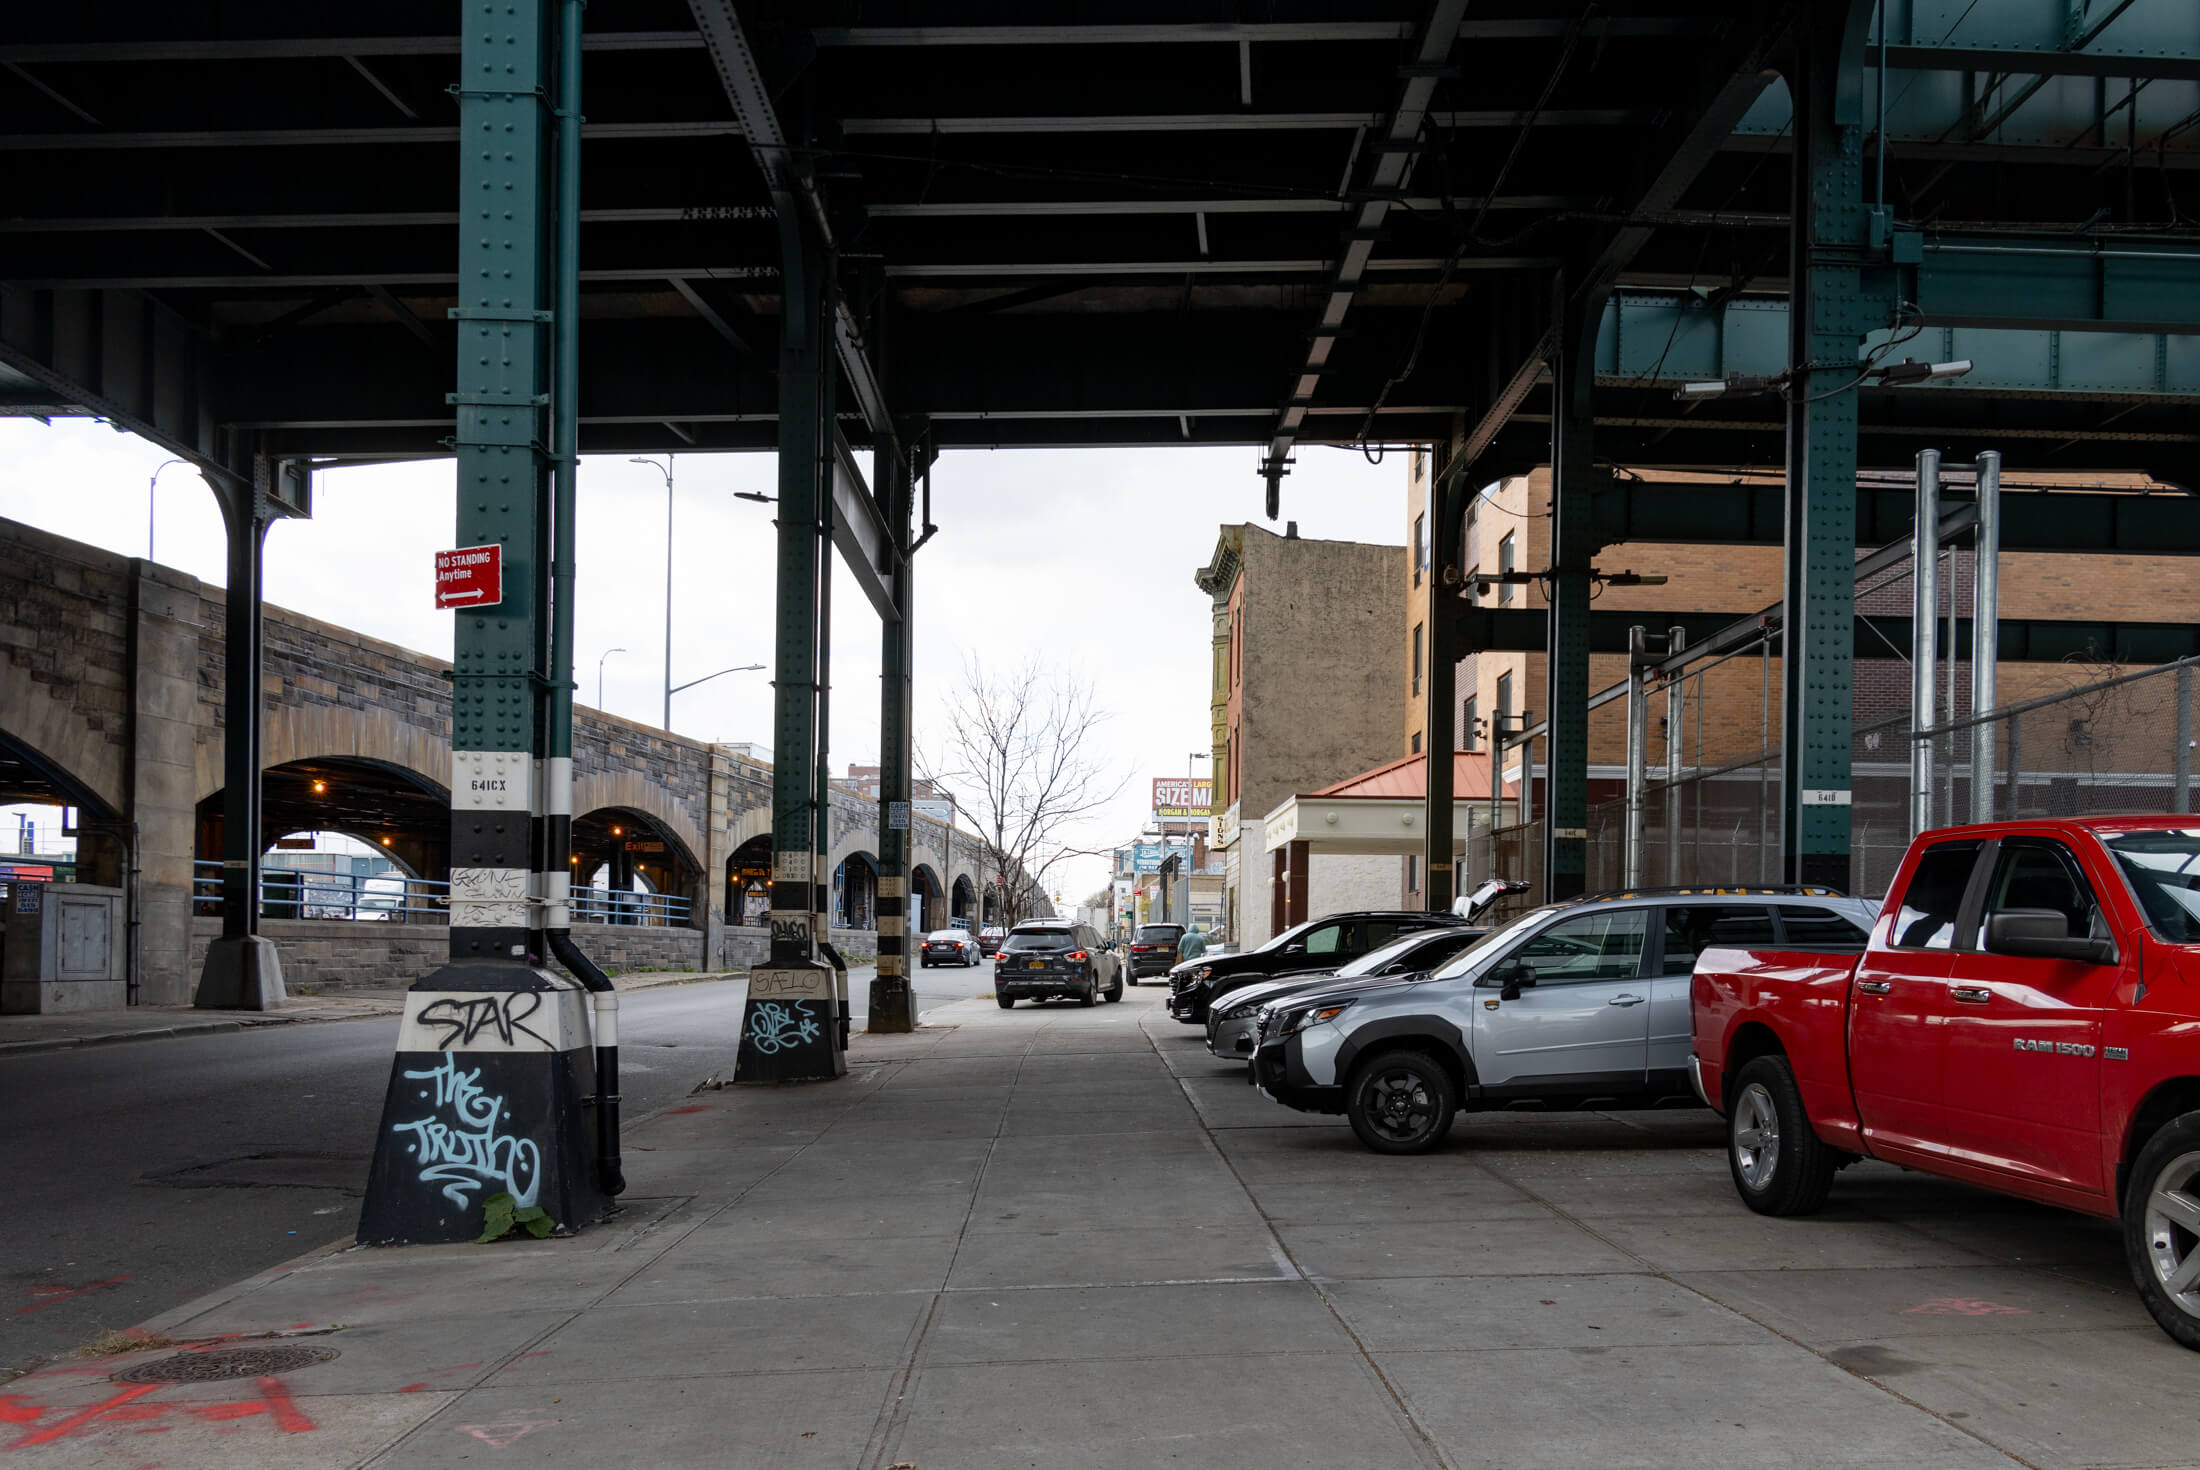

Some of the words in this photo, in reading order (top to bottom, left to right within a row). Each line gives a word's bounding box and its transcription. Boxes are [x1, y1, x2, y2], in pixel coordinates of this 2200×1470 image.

[438, 557, 450, 568] NO
[451, 552, 491, 567] STANDING
[439, 568, 472, 583] Anytime
[1156, 787, 1189, 806] SIZE
[417, 992, 558, 1050] STAR
[2013, 1038, 2054, 1053] RAM
[2056, 1041, 2095, 1058] 1500
